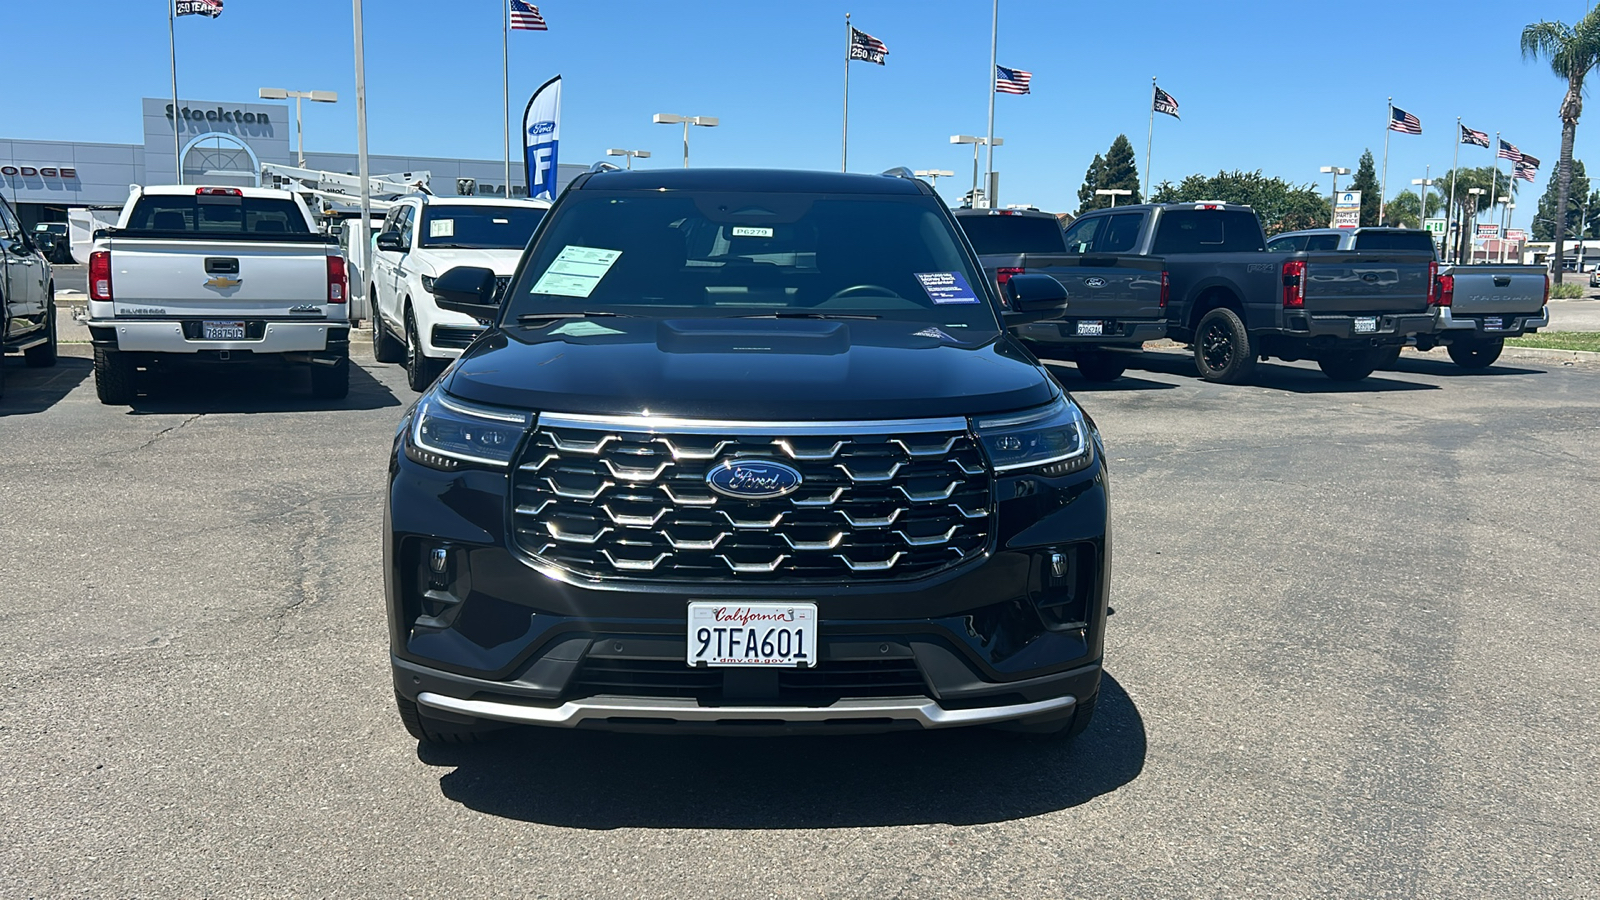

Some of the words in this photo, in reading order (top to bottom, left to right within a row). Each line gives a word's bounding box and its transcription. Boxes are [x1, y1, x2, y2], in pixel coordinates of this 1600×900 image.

[177, 3, 190, 13] 250
[852, 48, 868, 59] 250
[165, 103, 270, 124] Stockton
[533, 122, 553, 134] Ford
[0, 166, 76, 177] ODGE
[533, 147, 552, 185] F
[736, 228, 768, 236] P6279
[715, 606, 794, 626] California
[696, 628, 807, 658] 9TFA601
